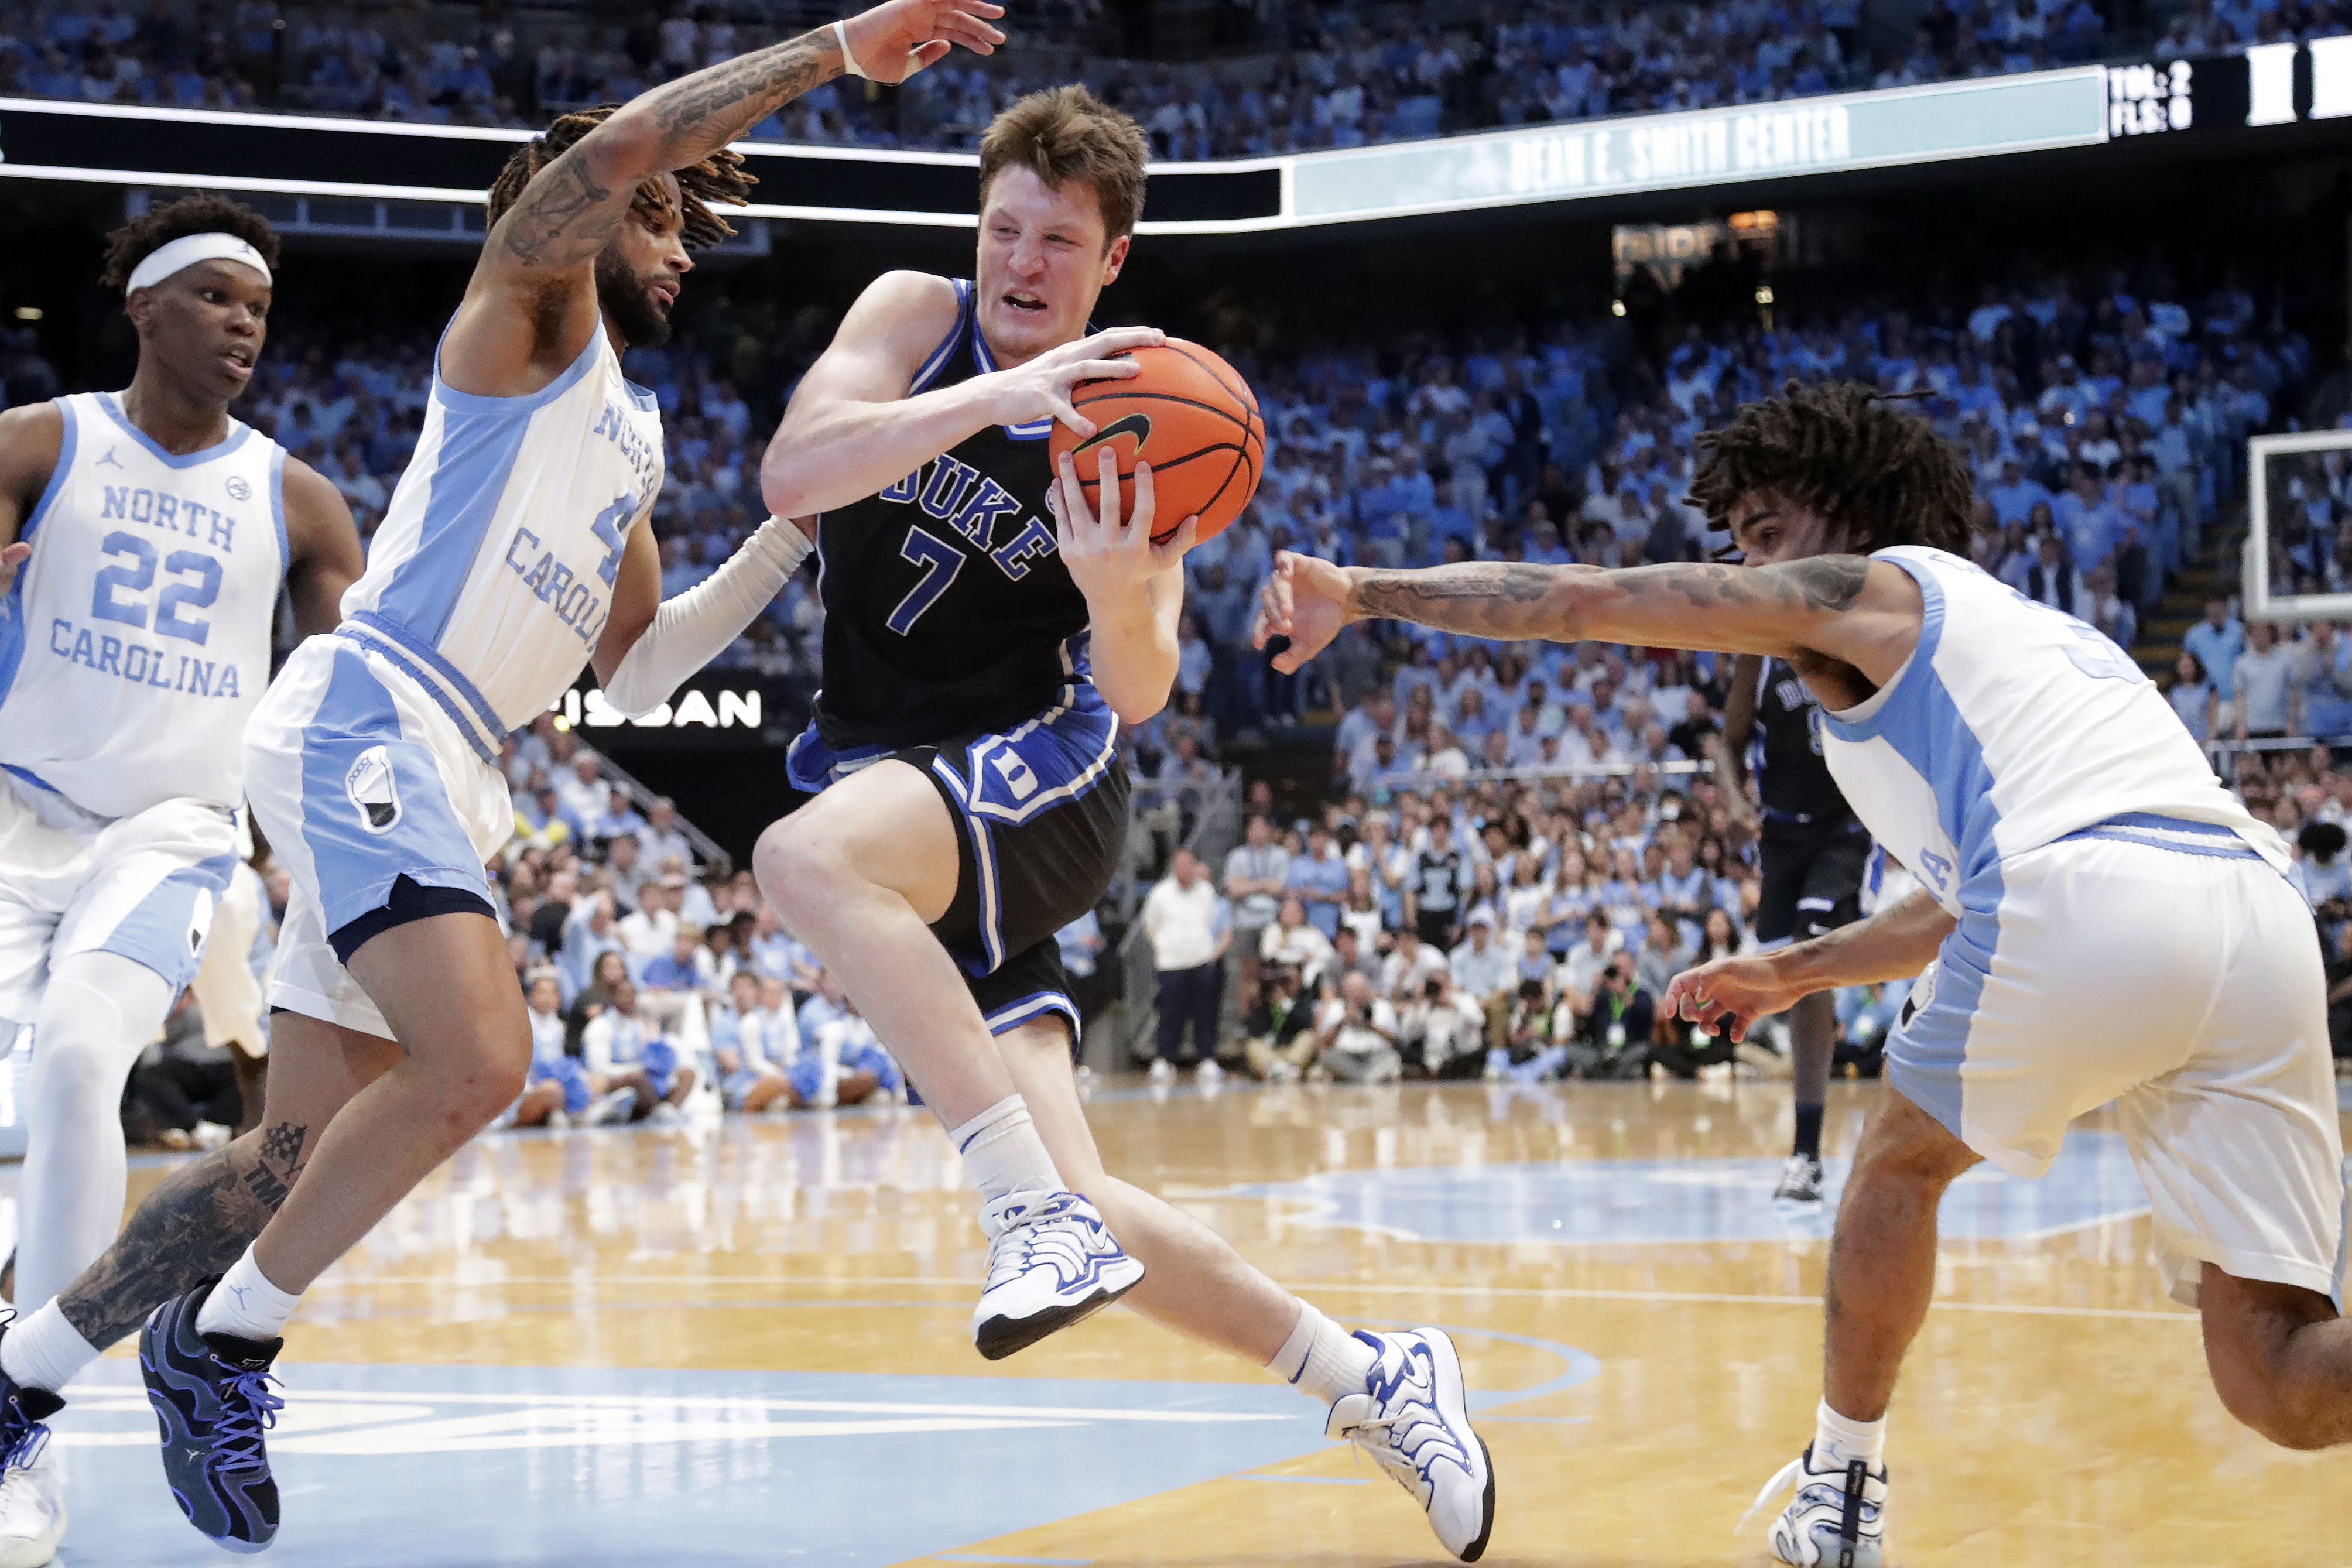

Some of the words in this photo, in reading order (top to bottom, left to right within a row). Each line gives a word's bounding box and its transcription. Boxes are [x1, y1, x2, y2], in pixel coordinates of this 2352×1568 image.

[1509, 135, 1586, 193] DEAN
[1630, 119, 1728, 180] SMITH
[1735, 106, 1850, 169] CENTER
[101, 485, 235, 554] NORTH
[91, 530, 224, 646] 22
[506, 526, 607, 653] CAROL
[885, 524, 967, 637] 7
[50, 618, 239, 698] CAROLINA
[548, 688, 762, 728] ISAN
